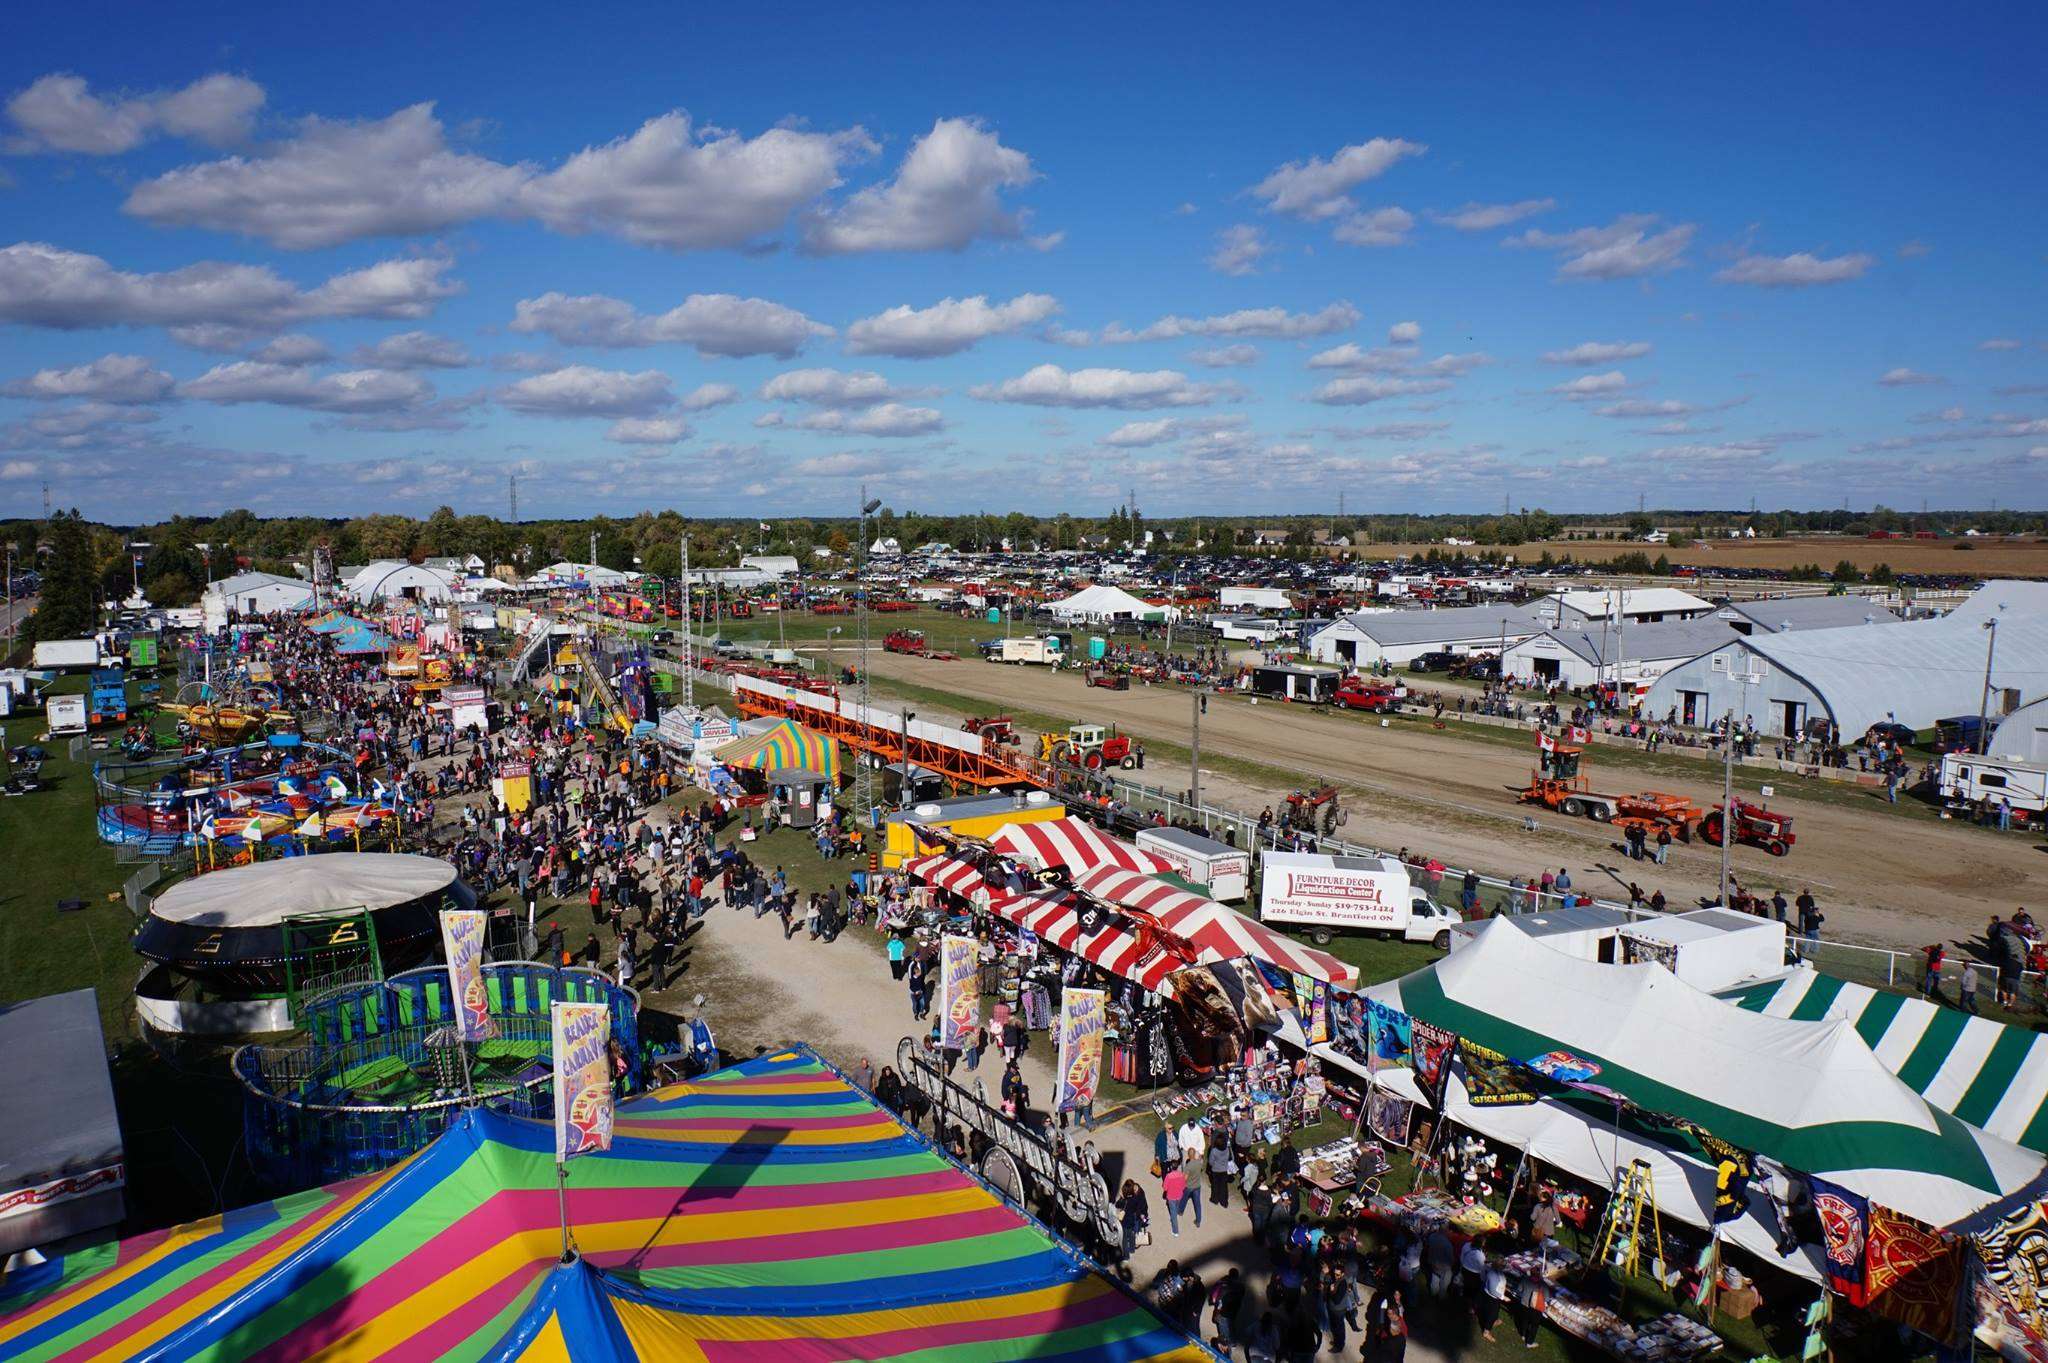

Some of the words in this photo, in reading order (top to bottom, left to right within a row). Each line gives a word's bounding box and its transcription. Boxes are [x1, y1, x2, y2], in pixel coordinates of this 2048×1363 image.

[703, 728, 729, 736] SOUVLAKI
[1296, 874, 1347, 887] FURNITURE
[1348, 877, 1375, 888] DECOR
[1296, 883, 1346, 896] Liquidation
[1347, 887, 1374, 898] Center
[1271, 898, 1302, 908] Thursday
[1307, 901, 1332, 910] Sunday
[1335, 903, 1394, 913] 519-753-1424
[1289, 909, 1313, 918] Elgin
[1331, 912, 1377, 921] Brantford
[1380, 914, 1394, 922] ON
[1068, 998, 1096, 1019] BEAUCE
[563, 1011, 599, 1046] BEAUCE
[1473, 1094, 1497, 1104] STICK
[1499, 1092, 1536, 1102] TOGETHE
[1824, 1199, 1845, 1213] FIRE
[1899, 1228, 1926, 1244] FIRE
